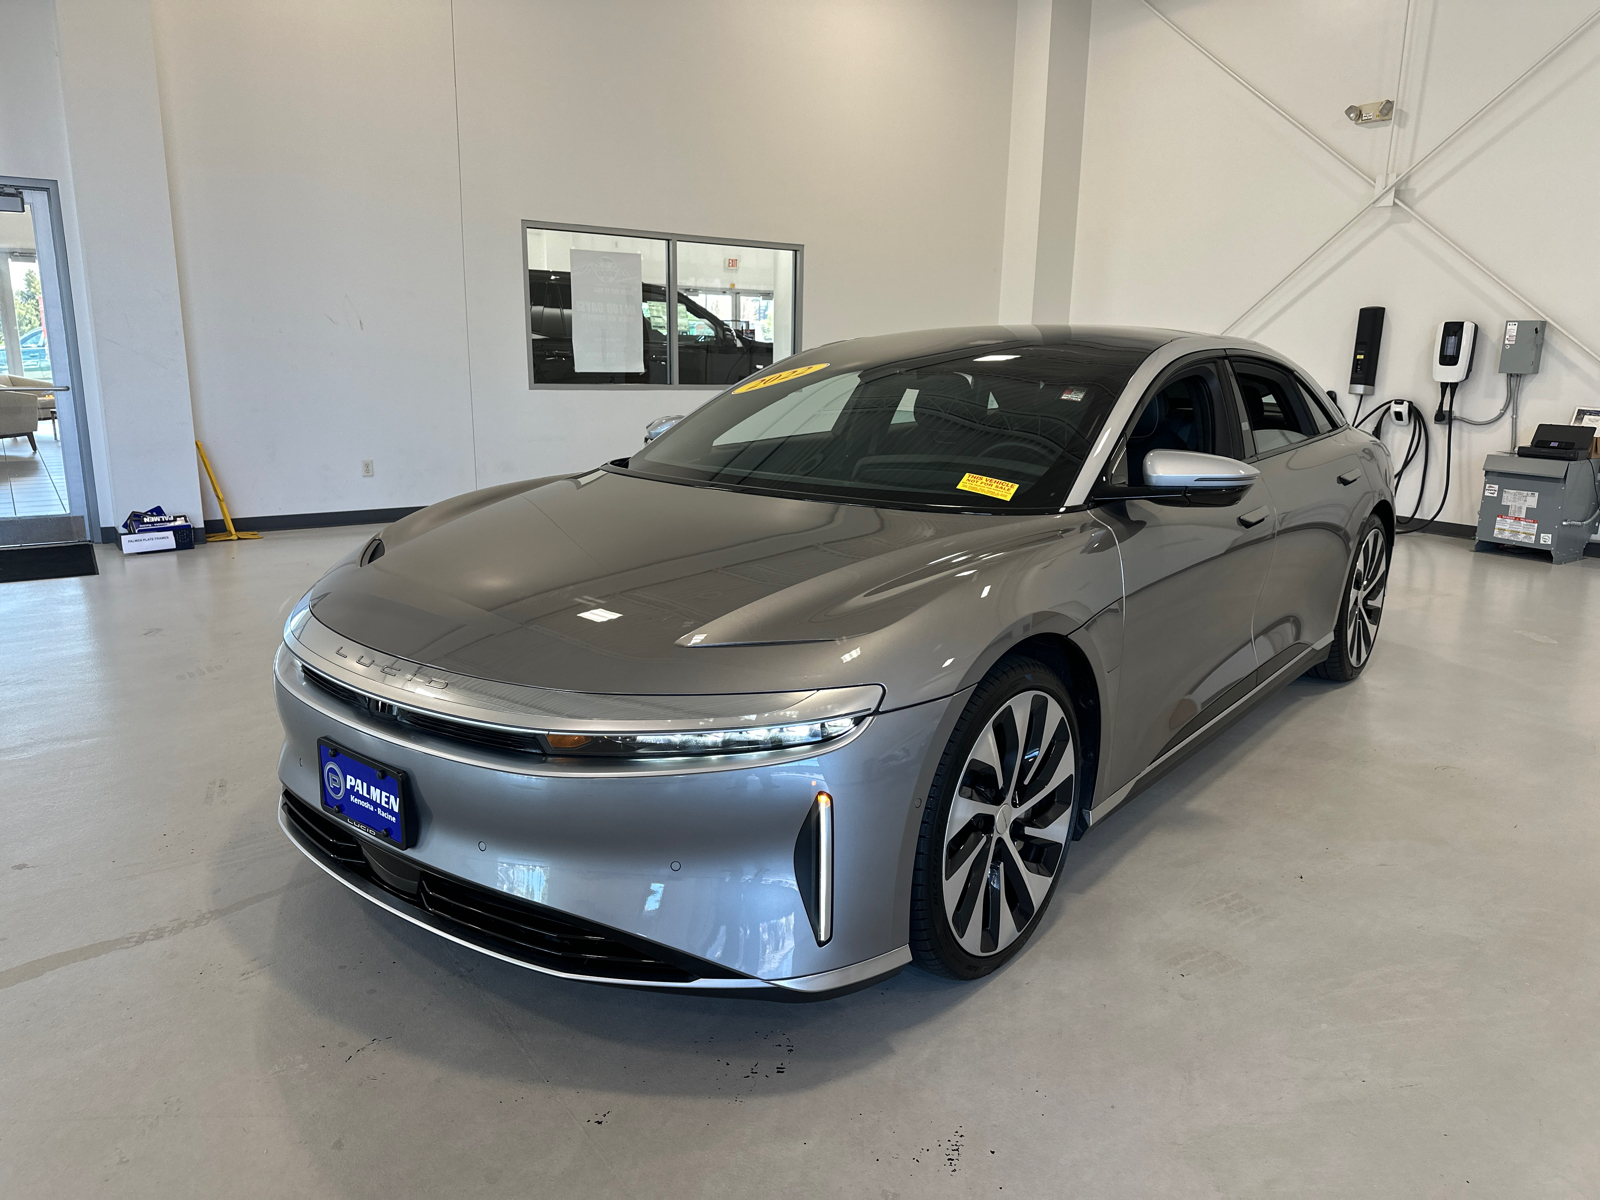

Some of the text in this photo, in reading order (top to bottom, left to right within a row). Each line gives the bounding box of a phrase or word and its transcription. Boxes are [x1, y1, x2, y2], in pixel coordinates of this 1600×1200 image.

[745, 366, 814, 391] 2022
[979, 480, 994, 488] FOR
[995, 484, 1012, 492] SALE
[985, 477, 1016, 489] VEHICLE
[335, 646, 449, 689] LUCID
[346, 774, 400, 813] PALMEN
[350, 794, 374, 812] Kenosha
[377, 807, 397, 823] Racine
